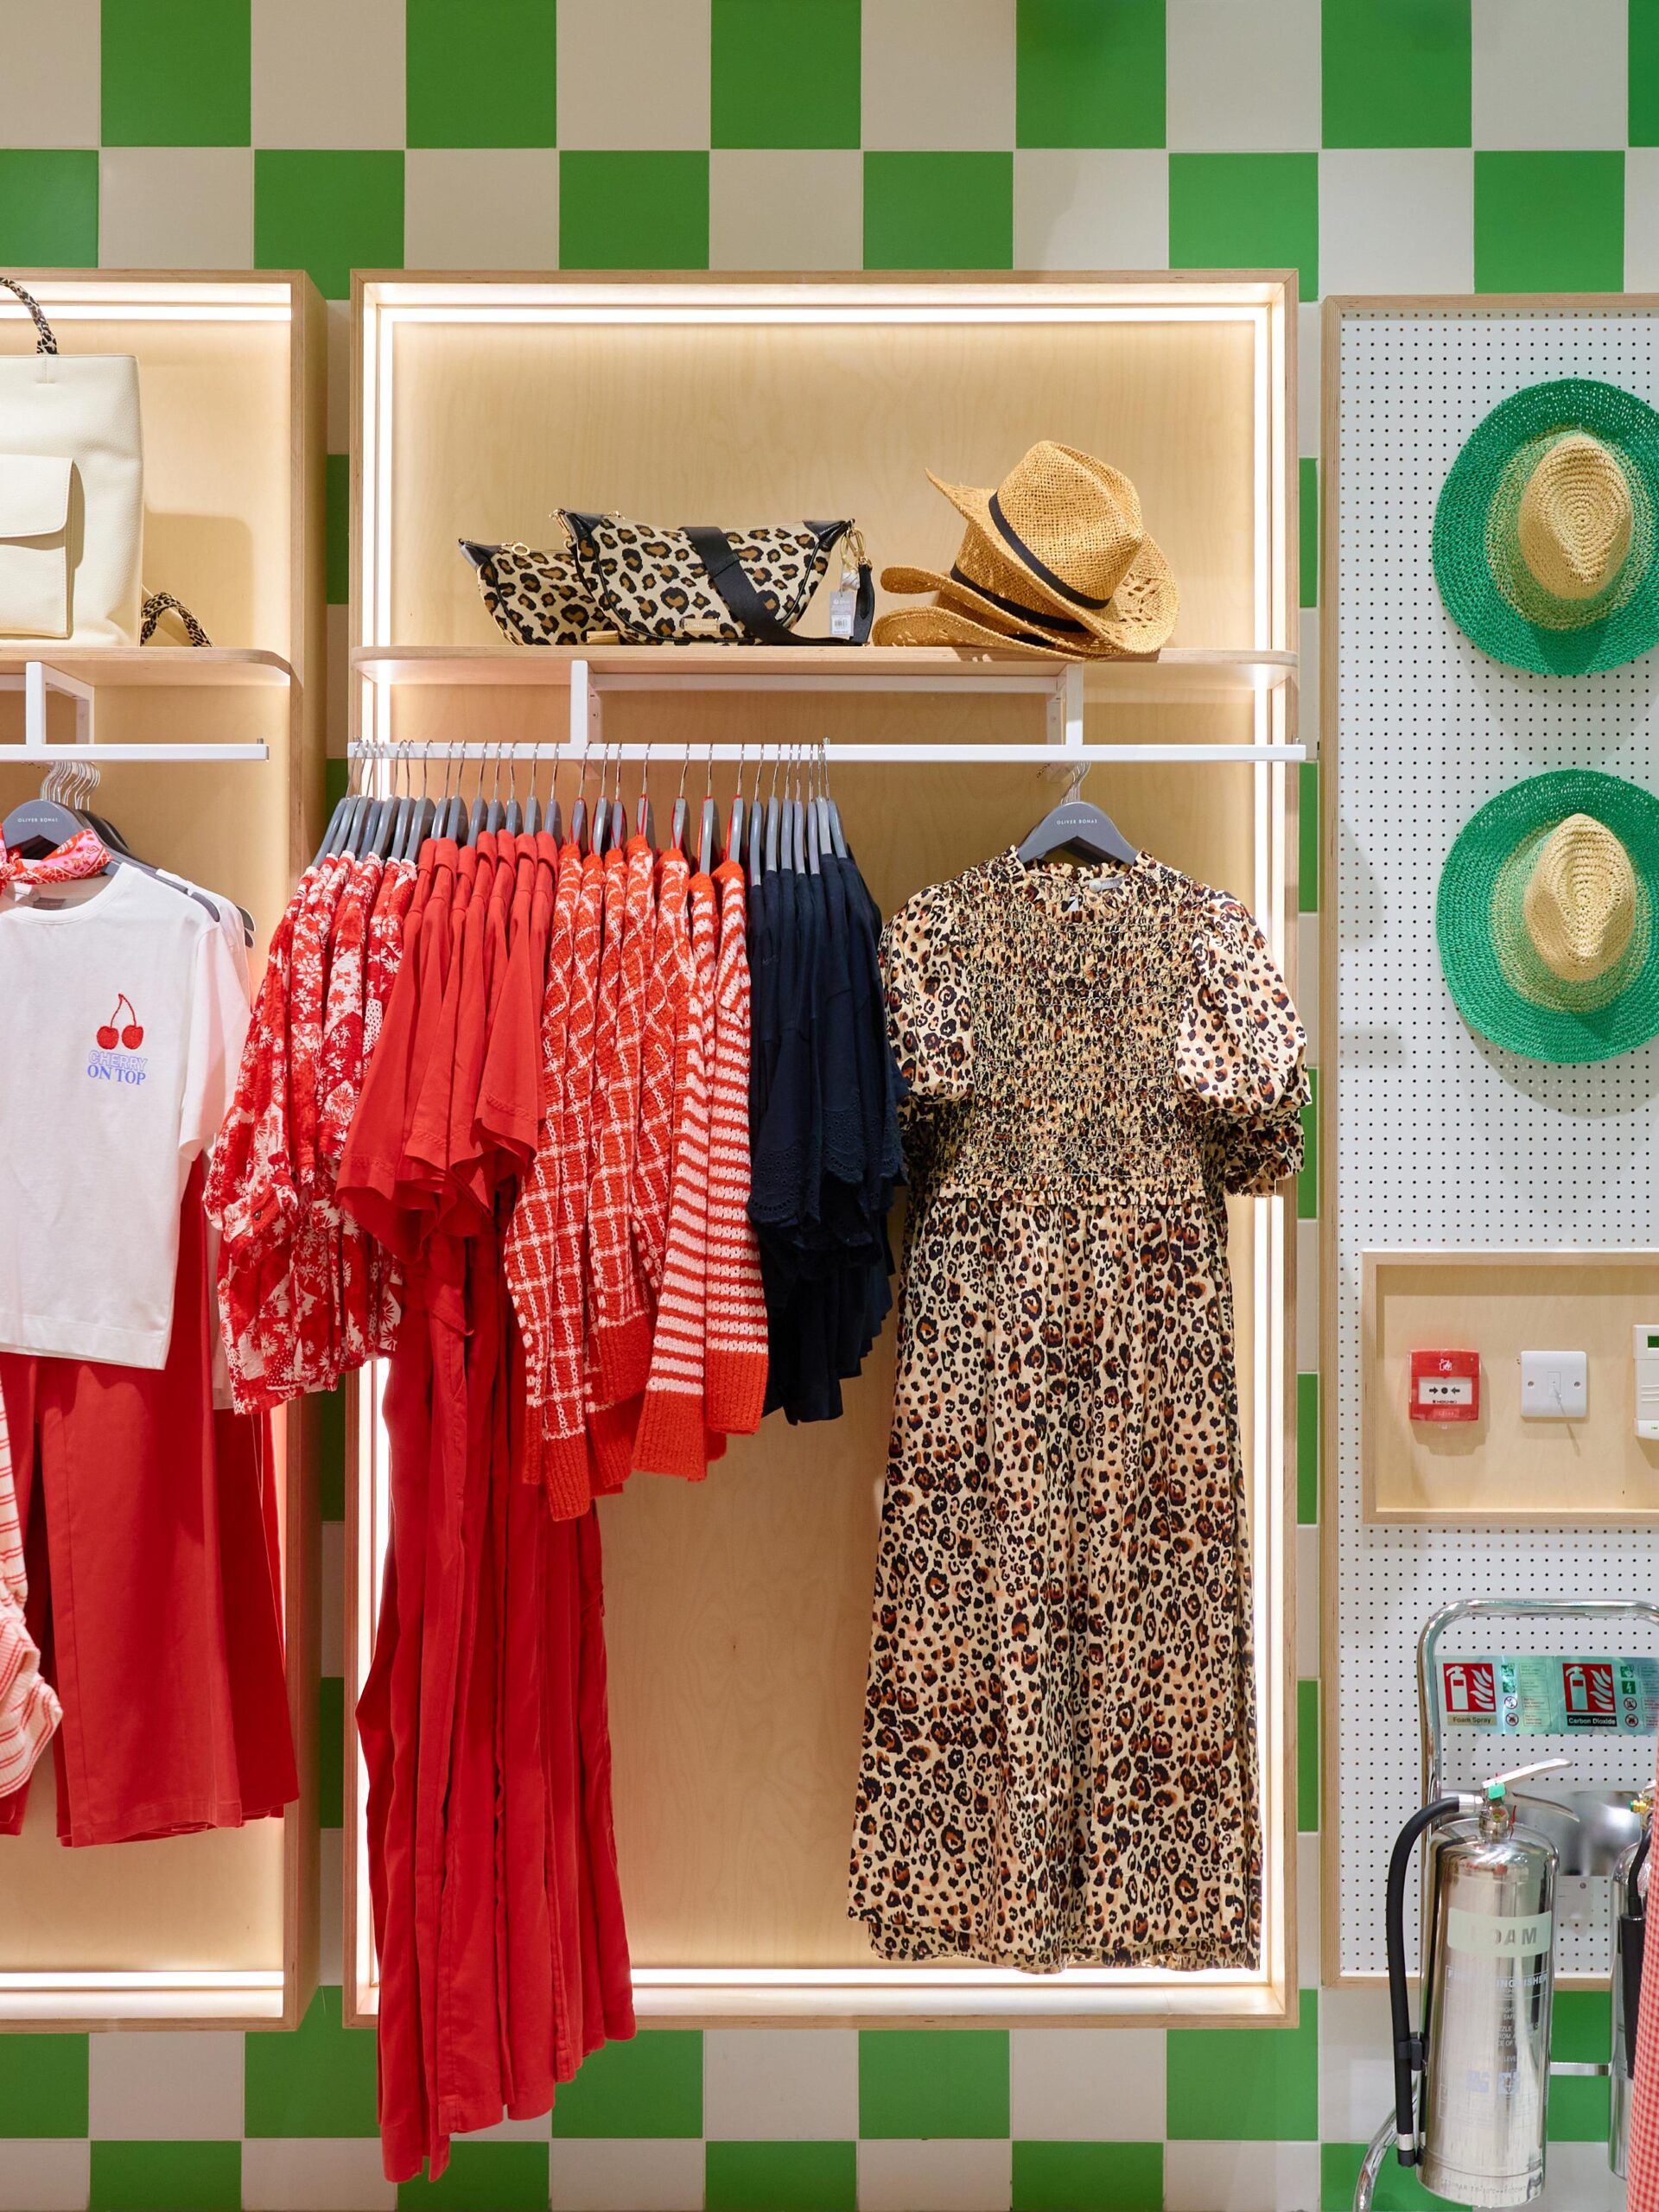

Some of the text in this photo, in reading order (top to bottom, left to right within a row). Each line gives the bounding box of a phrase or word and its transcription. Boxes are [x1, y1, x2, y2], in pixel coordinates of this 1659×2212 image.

[89, 1050, 148, 1072] CHERRY
[87, 1065, 146, 1085] ON TOP
[1471, 1716, 1491, 1725] Spray
